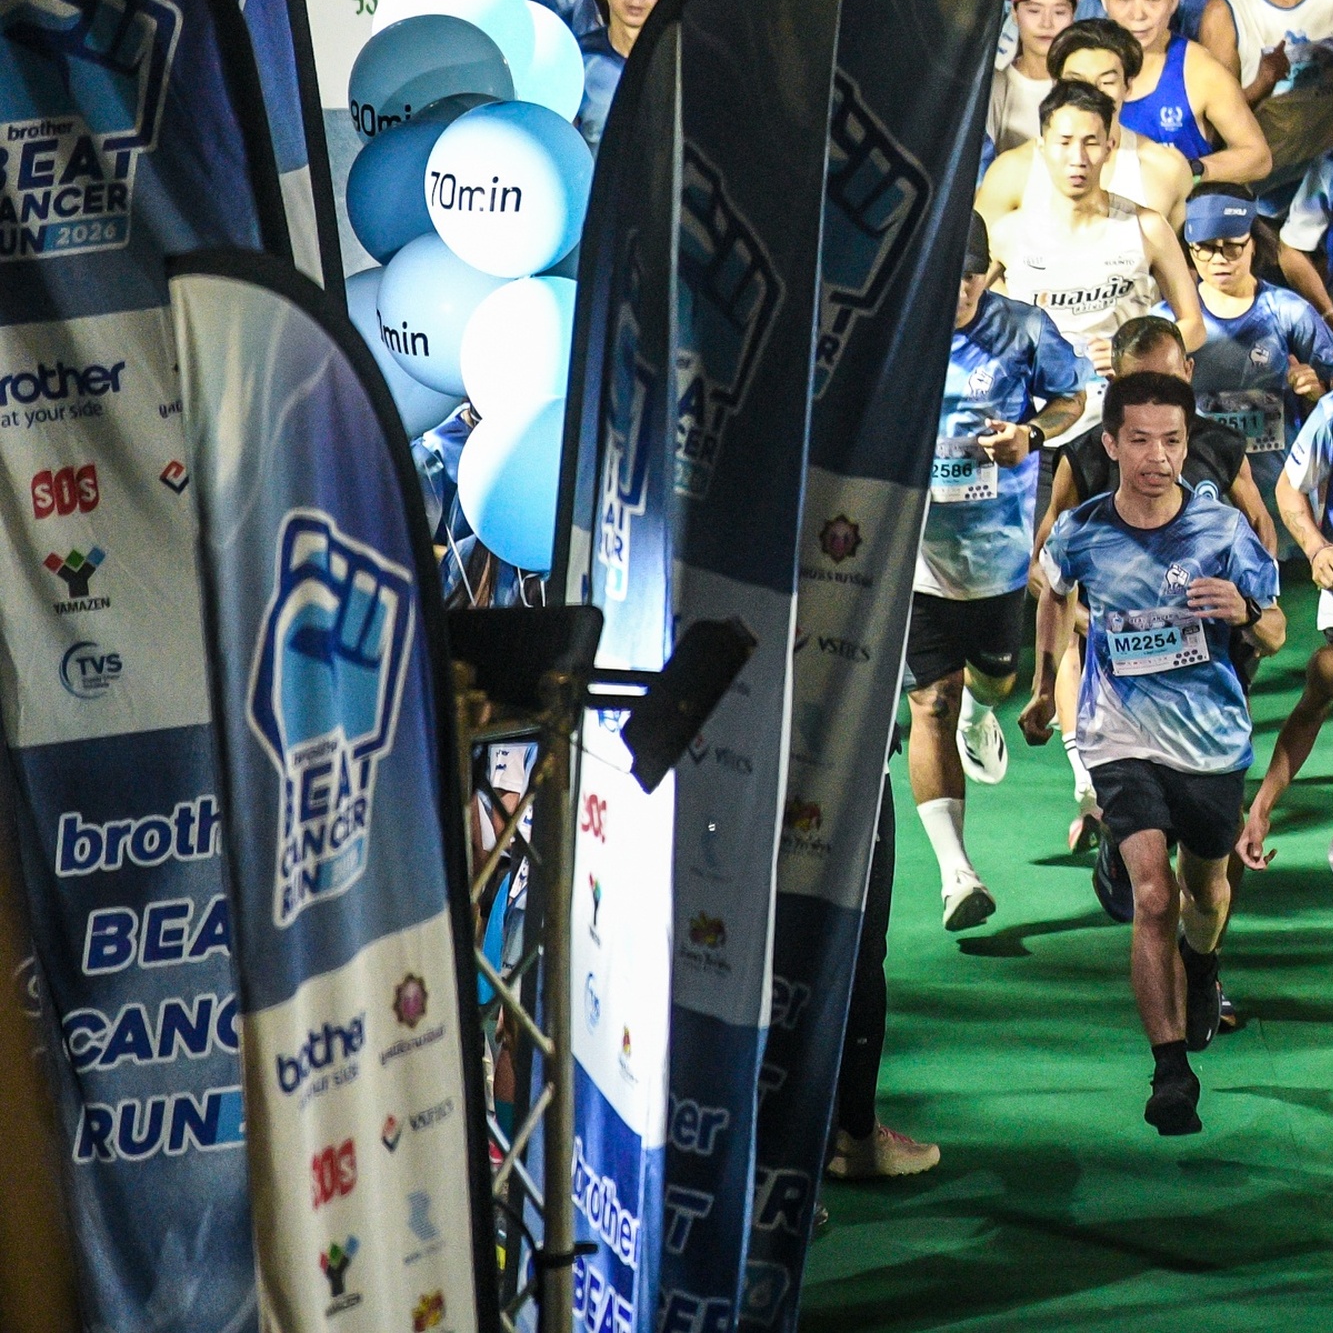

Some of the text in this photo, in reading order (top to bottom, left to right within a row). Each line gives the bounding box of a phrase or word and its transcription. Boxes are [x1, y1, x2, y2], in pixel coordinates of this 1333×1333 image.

[0, 182, 129, 225] ANCER
[429, 170, 522, 214] 70min
[56, 221, 117, 246] 2026
[26, 404, 66, 430] your
[69, 401, 103, 419] side
[931, 463, 974, 479] 2586
[53, 596, 111, 615] YAMAZEN
[1114, 631, 1178, 654] M2254
[76, 653, 123, 676] TVS
[86, 899, 232, 971] BEA
